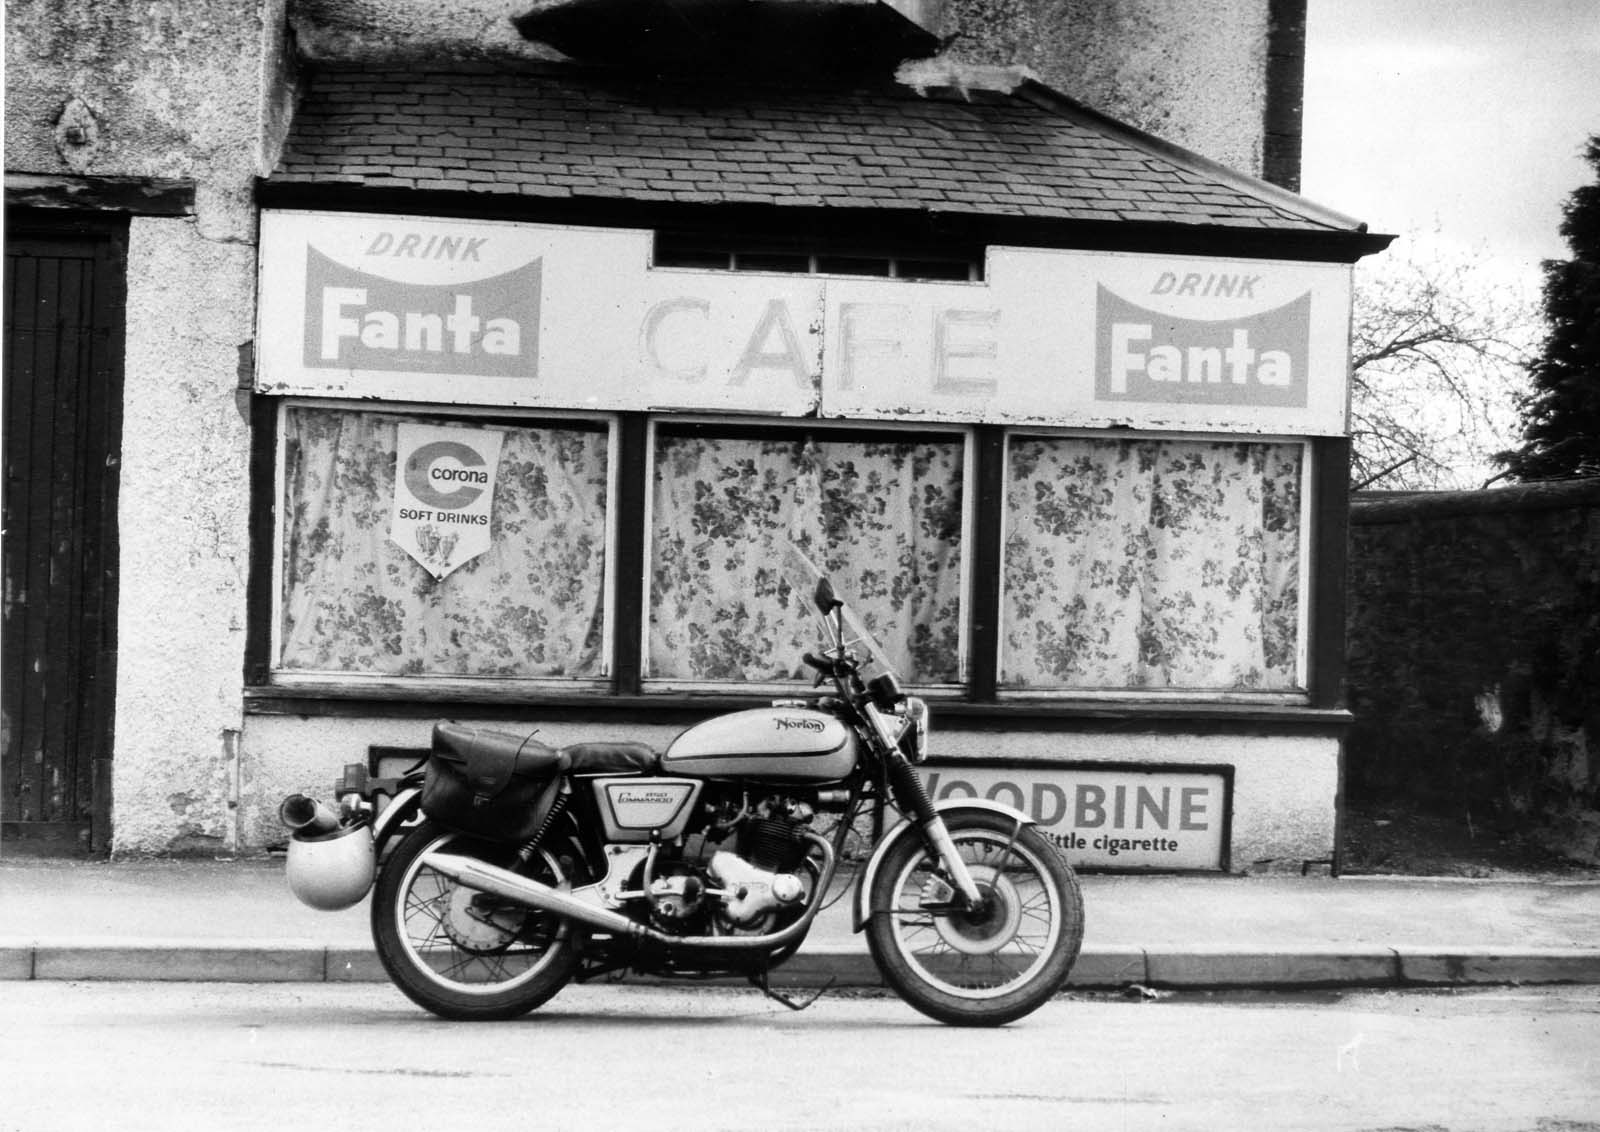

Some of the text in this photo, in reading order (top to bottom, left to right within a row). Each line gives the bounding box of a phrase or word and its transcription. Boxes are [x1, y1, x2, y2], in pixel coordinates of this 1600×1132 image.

[365, 231, 489, 262] DRINK
[1149, 271, 1262, 298] DRINK
[321, 286, 523, 359] Fanta
[639, 296, 1000, 394] CAFE
[1111, 322, 1292, 393] Fanta
[431, 468, 488, 483] corona
[400, 508, 488, 526] SOFT DRINKS
[773, 717, 825, 733] Norton
[1044, 831, 1178, 856] ttle cigarette
